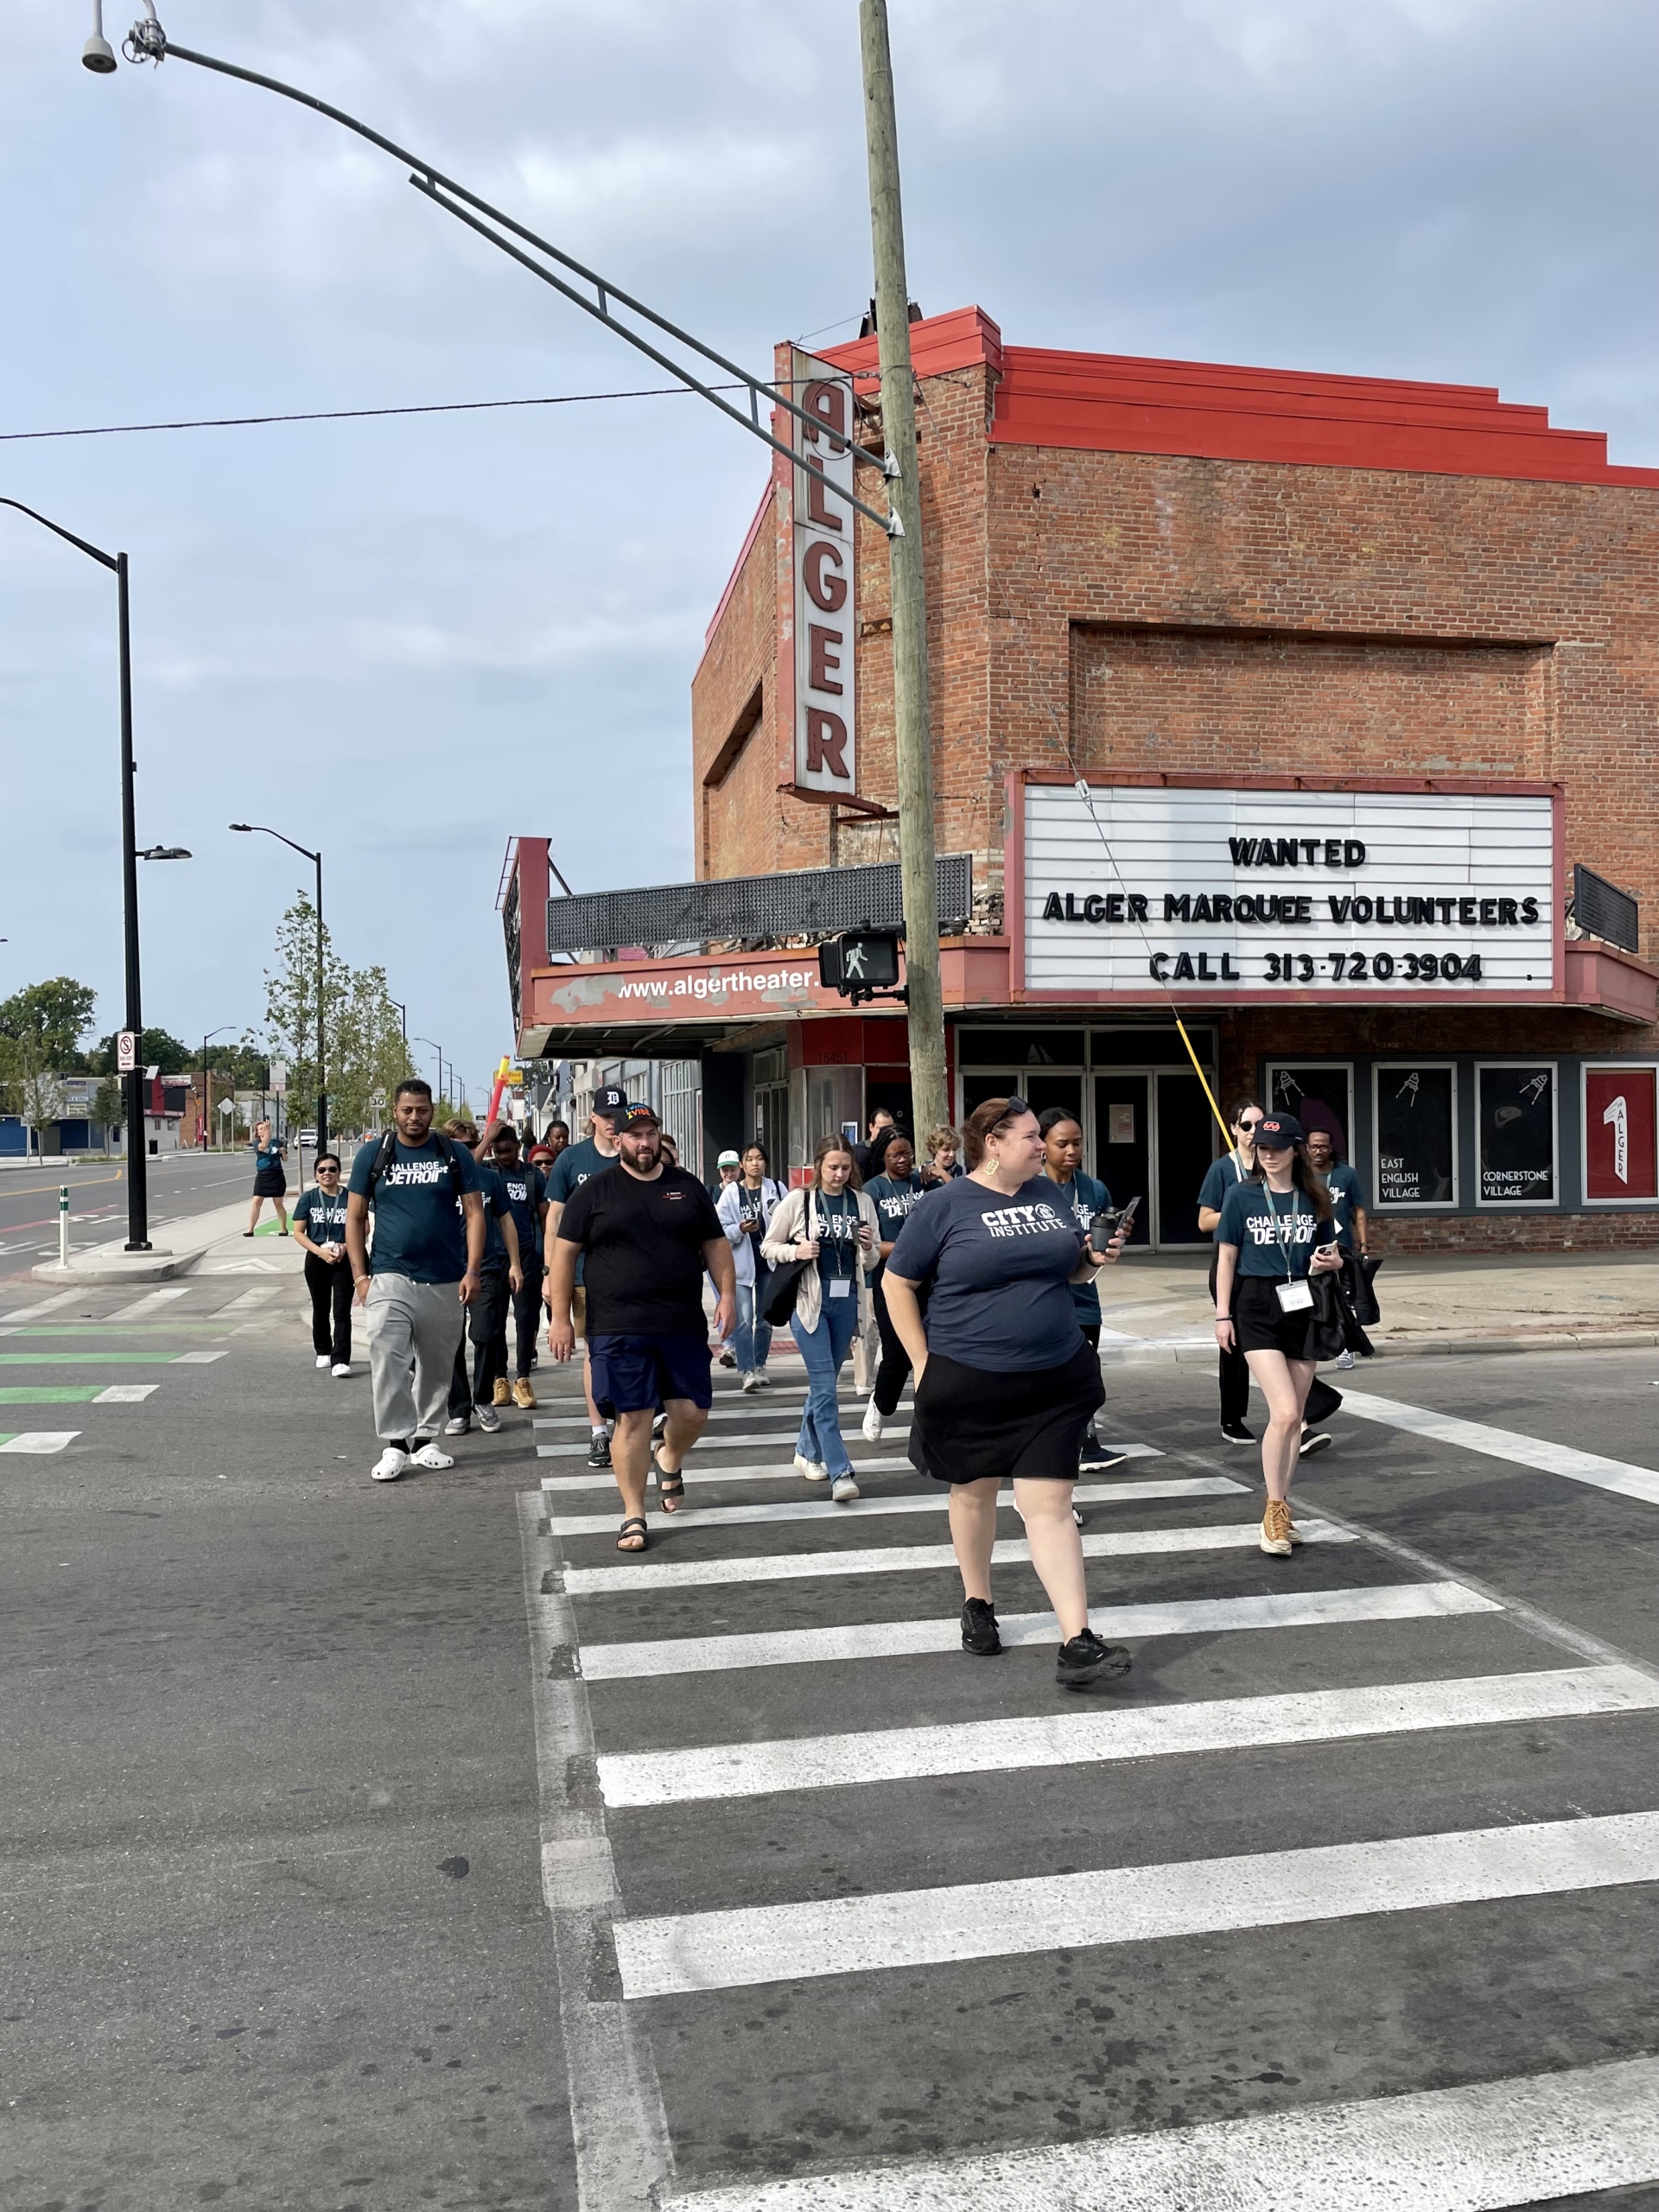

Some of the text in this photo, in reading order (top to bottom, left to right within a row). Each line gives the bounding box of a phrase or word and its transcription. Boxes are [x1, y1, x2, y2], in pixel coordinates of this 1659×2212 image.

[803, 381, 849, 779] ALGER
[1229, 837, 1366, 867] WANTED
[1043, 893, 1539, 925] ALGER MARQUEE VOLUNTEERS
[1149, 953, 1240, 981] CALL
[818, 1051, 847, 1064] 16451
[371, 1097, 385, 1106] 30
[1381, 1158, 1404, 1169] EAST
[1382, 1173, 1419, 1184] ENGLISH
[1483, 1170, 1548, 1181] CORNERSTONE
[1382, 1187, 1421, 1198] VILLAGE
[1483, 1185, 1522, 1196] VILLAGE
[981, 1205, 1036, 1227] CITY
[988, 1218, 1067, 1237] INSTITUTE
